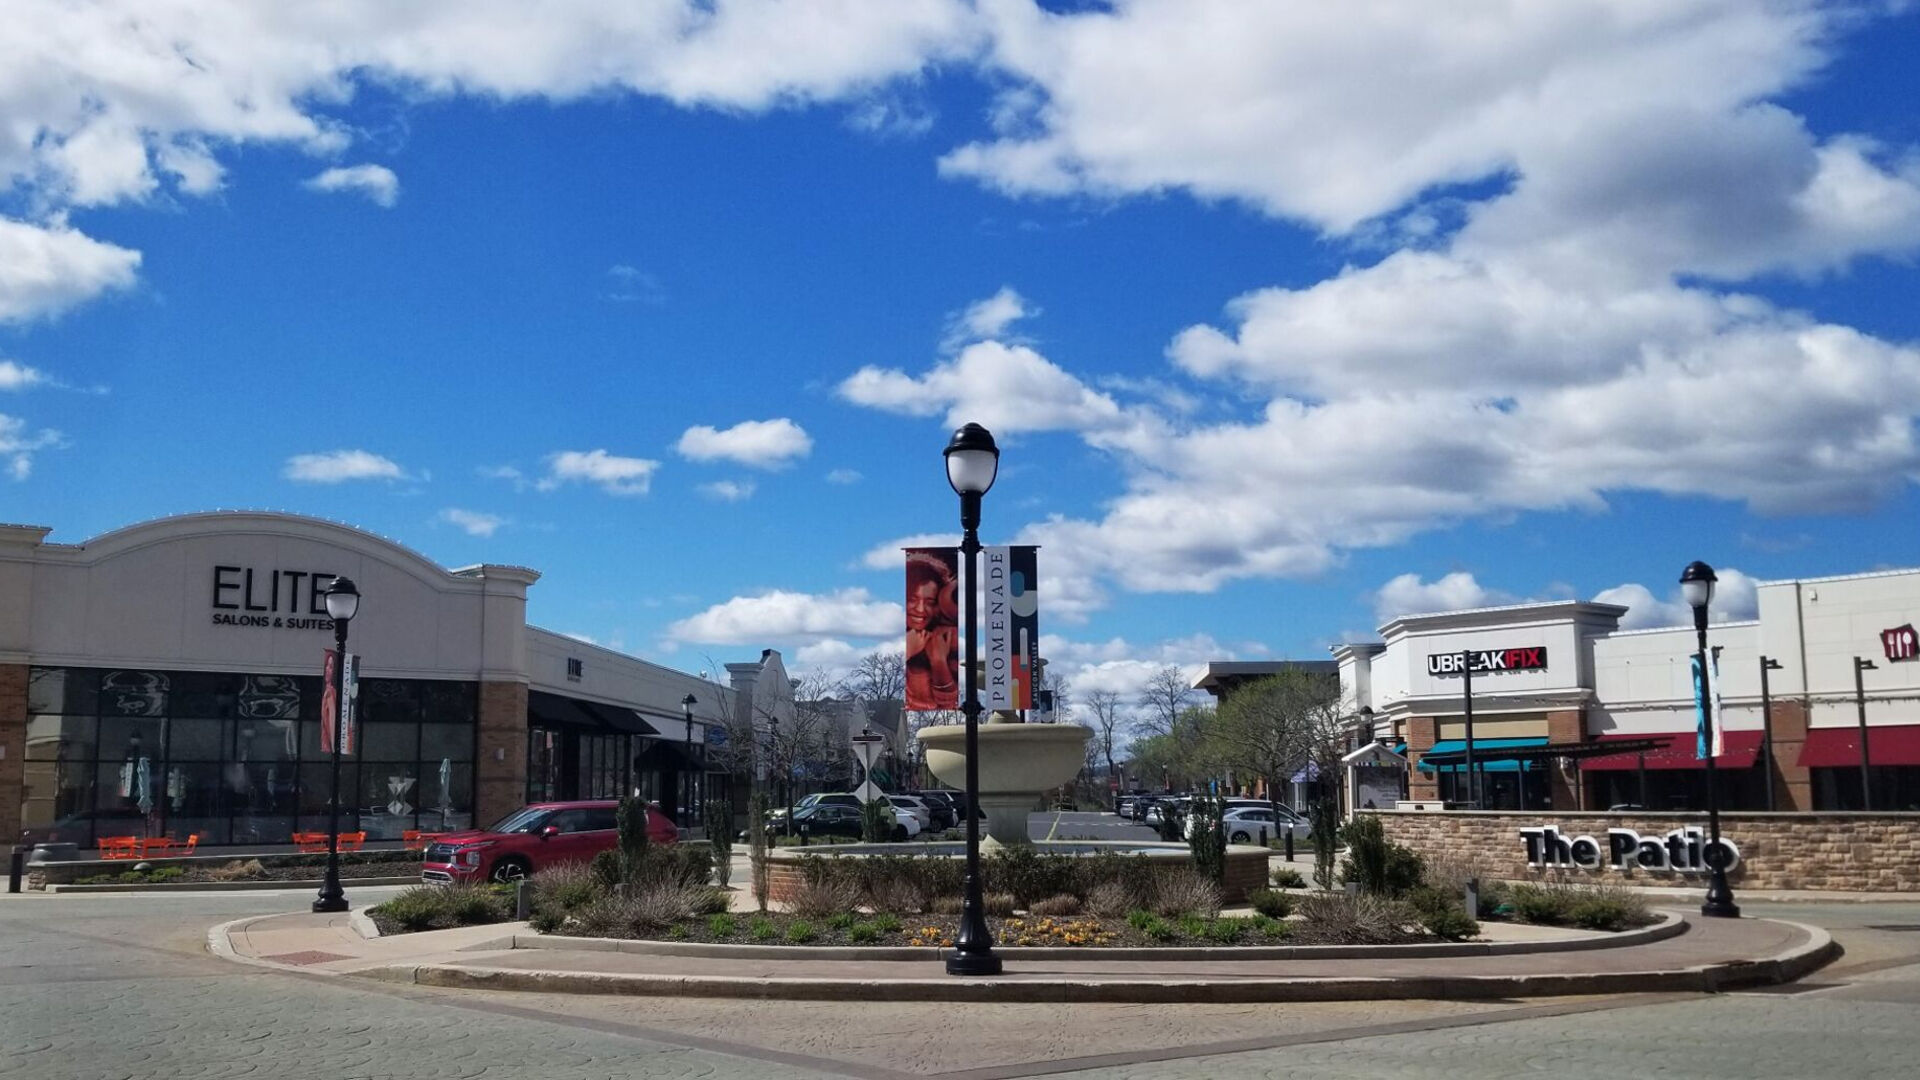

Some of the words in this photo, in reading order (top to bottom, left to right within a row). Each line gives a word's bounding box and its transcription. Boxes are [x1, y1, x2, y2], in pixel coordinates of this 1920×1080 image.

[213, 565, 337, 614] ELITE
[212, 613, 270, 627] SALONS
[273, 617, 283, 629] &
[287, 617, 335, 631] SUITES
[991, 553, 1005, 702] PROMENADE
[1520, 824, 1600, 870] The
[1608, 826, 1740, 873] Patio
